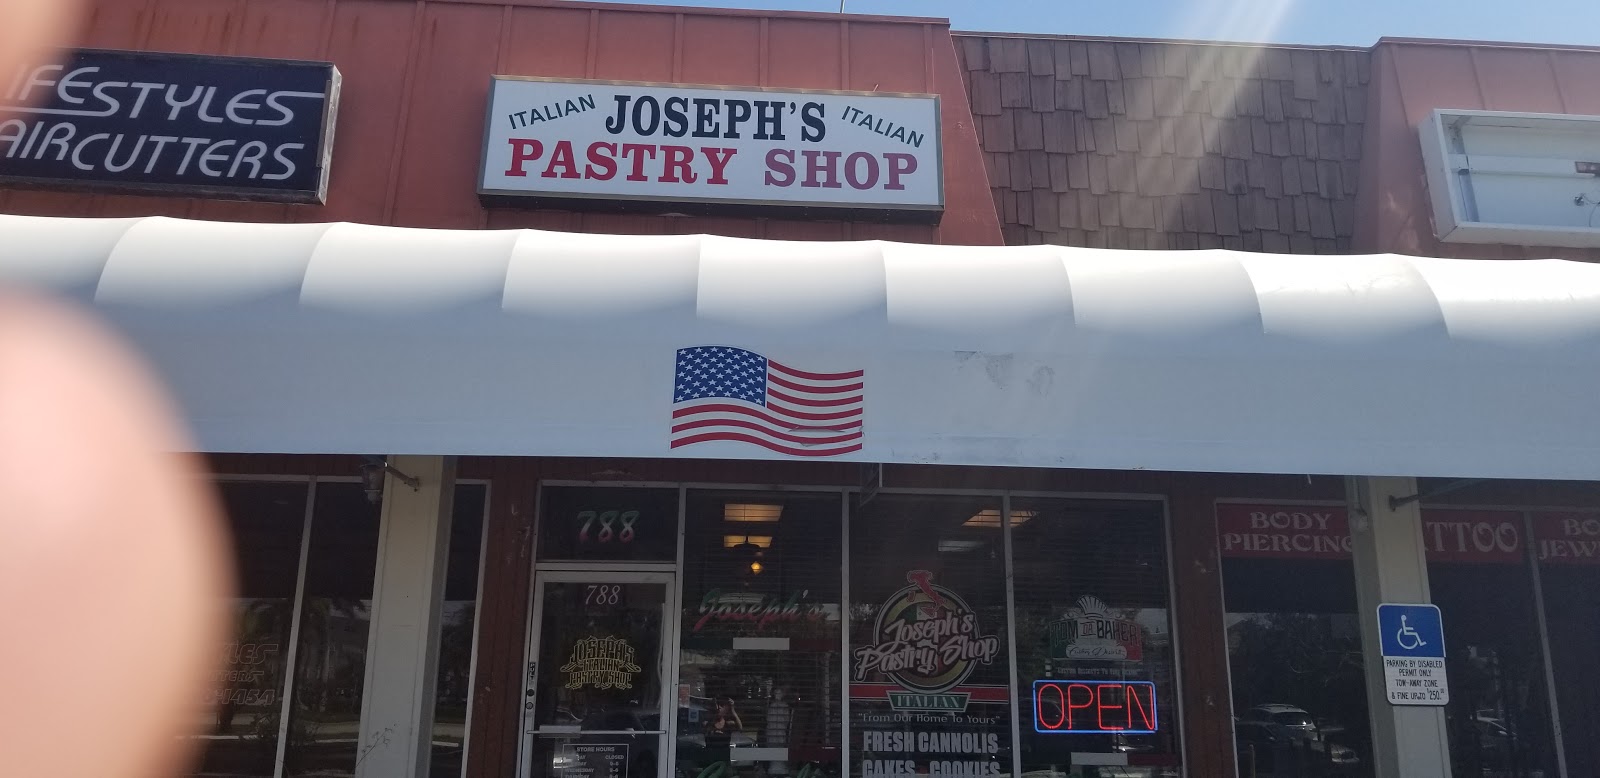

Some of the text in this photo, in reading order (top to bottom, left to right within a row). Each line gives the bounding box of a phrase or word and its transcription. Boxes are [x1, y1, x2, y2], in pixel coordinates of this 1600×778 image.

[3, 63, 326, 127] IFESTYLES
[508, 93, 596, 130] ITALIAN
[605, 94, 826, 143] JOSEPH'S
[840, 105, 925, 149] ITALIAN
[0, 118, 305, 181] AIRCUTTERS
[504, 138, 919, 191] PASTRY SHOP
[576, 510, 640, 544] 788
[1249, 510, 1333, 531] BODY
[1424, 521, 1519, 553] TTOO
[1562, 517, 1600, 537] BO
[584, 585, 622, 606] 788
[693, 588, 828, 632] Joseph's
[882, 607, 976, 650] Joseph's
[854, 630, 1002, 682] Pastry Shop
[1386, 659, 1443, 668] PARKING BY DISABLED
[1395, 679, 1439, 688] TOW-AWAY ZONE
[1398, 669, 1432, 677] PERMIT ONLY
[895, 693, 962, 709] ITALIAN
[1037, 683, 1156, 731] OPEN
[1397, 692, 1409, 700] FINE
[893, 713, 914, 724] Our
[916, 713, 949, 725] Home
[952, 713, 964, 725] To
[863, 731, 999, 754] FRESH CANNOLIS
